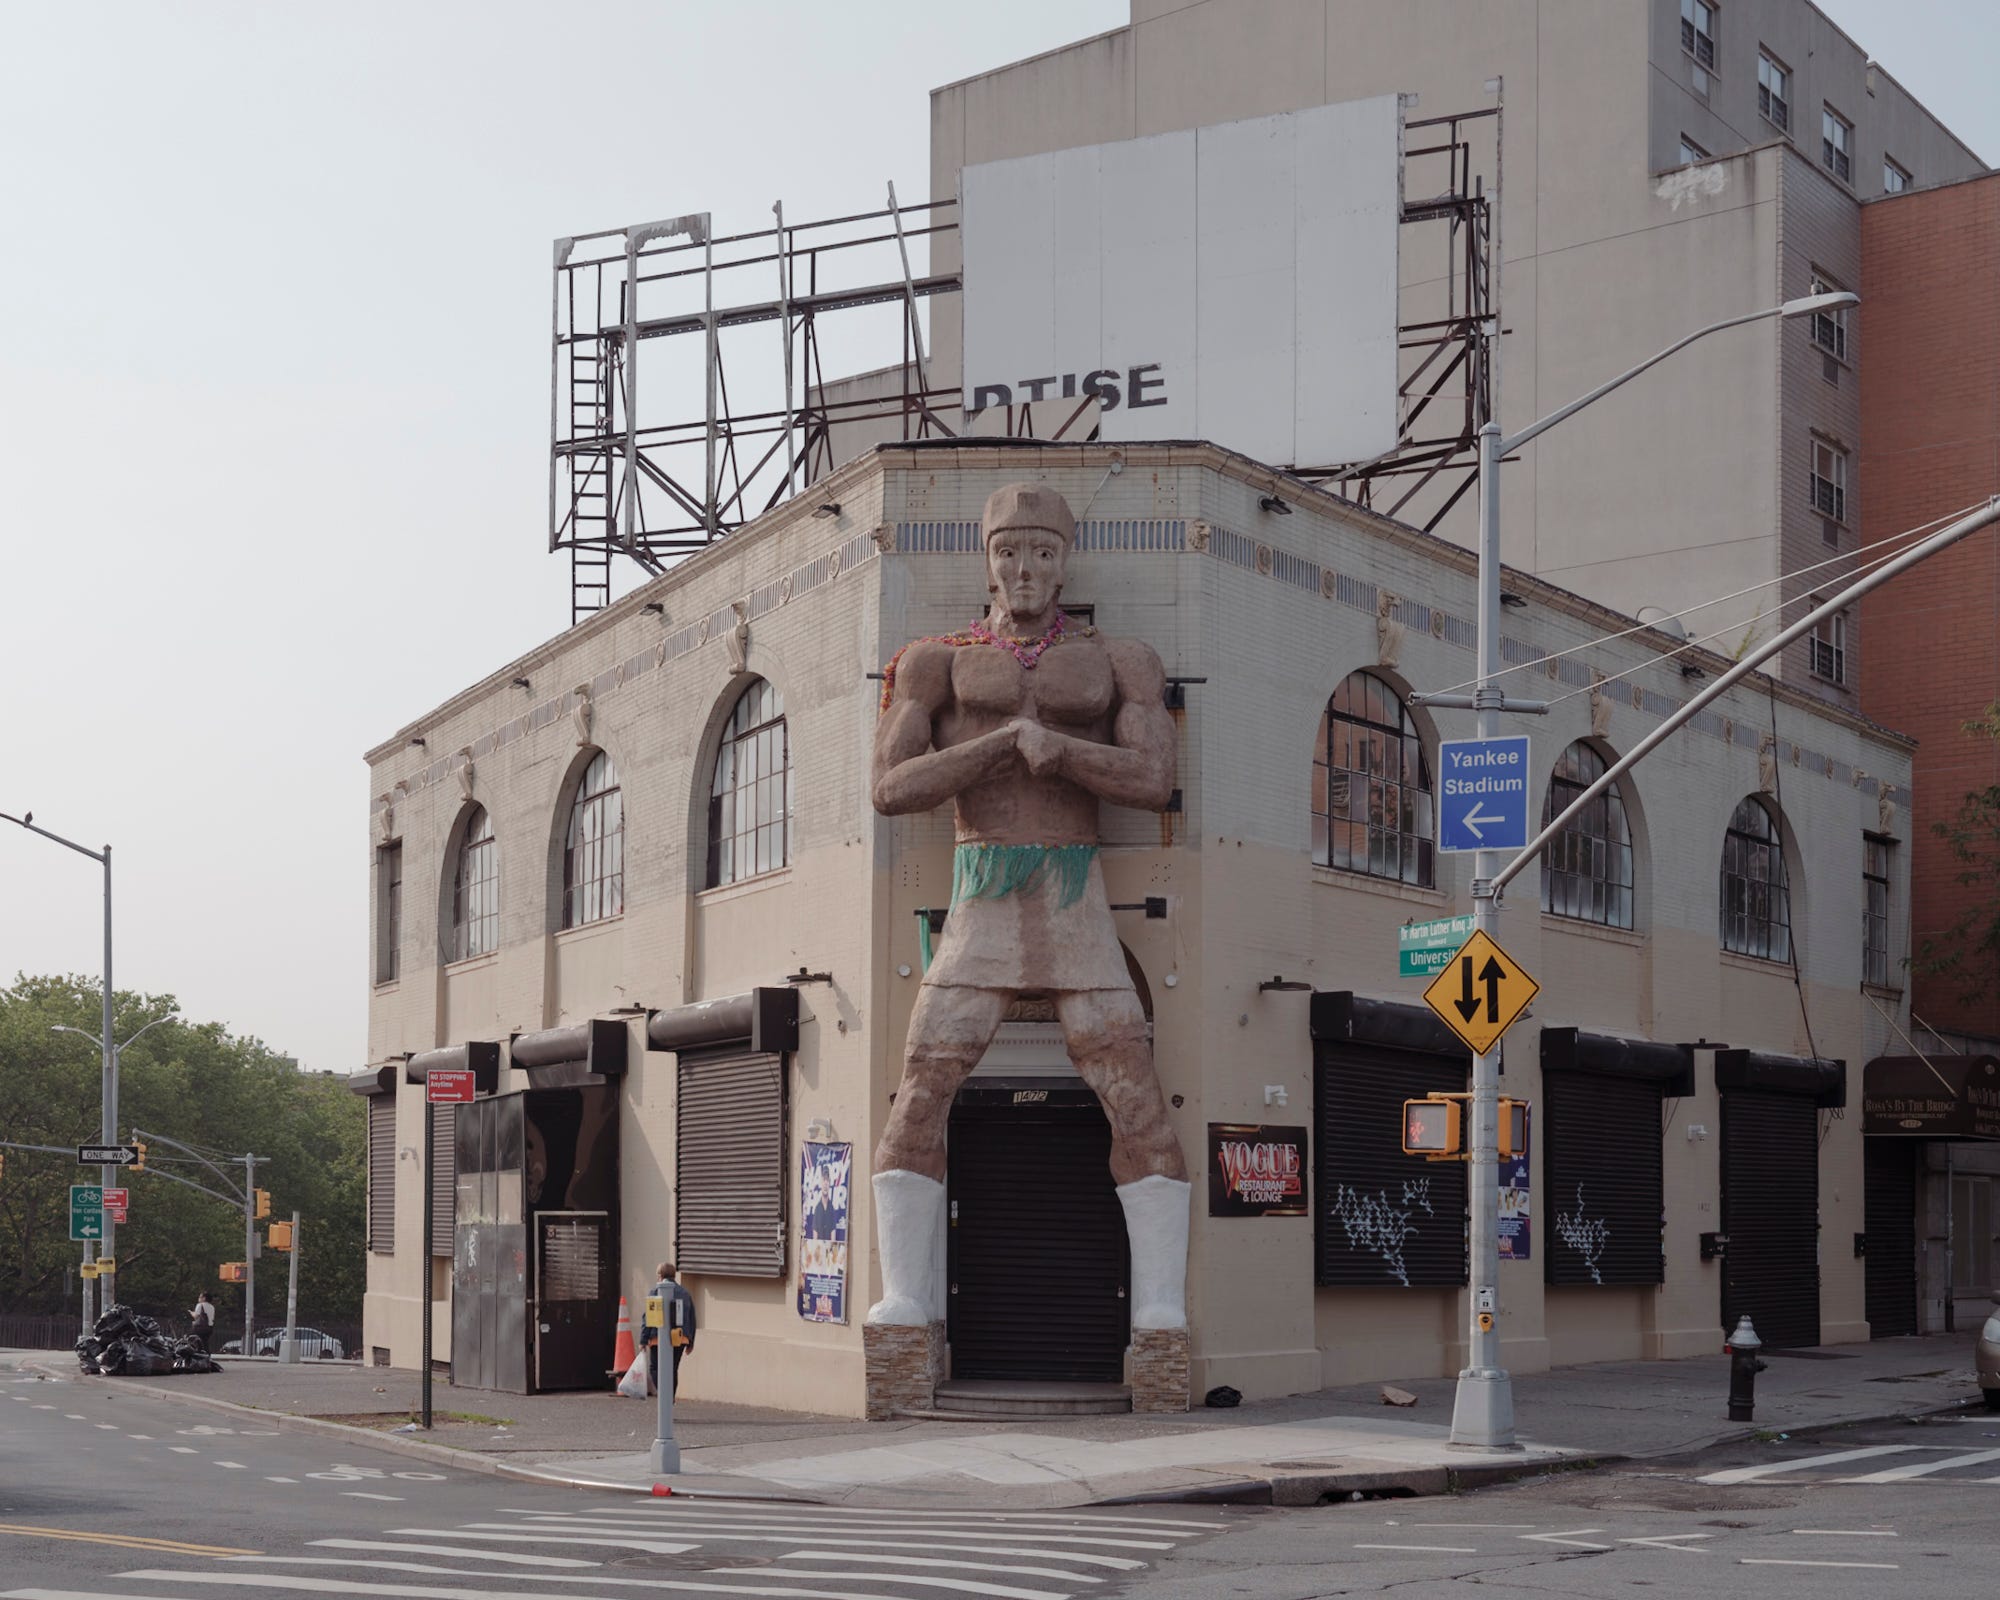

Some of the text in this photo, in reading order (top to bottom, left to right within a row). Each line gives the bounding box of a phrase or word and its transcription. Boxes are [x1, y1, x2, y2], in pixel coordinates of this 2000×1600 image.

[1450, 750, 1519, 769] Yankee
[1445, 777, 1522, 795] Stadium
[1400, 927, 1409, 941] Dr
[1409, 925, 1429, 940] Martin
[1430, 922, 1450, 937] Luther
[1451, 918, 1466, 935] King
[1410, 949, 1455, 966] Universit
[1015, 1091, 1047, 1102] 1472
[86, 1151, 130, 1159] ONE WAY
[1220, 1141, 1299, 1178] VOGUE
[1239, 1180, 1286, 1192] RESTAURANT
[1243, 1191, 1283, 1203] & LOUNGE
